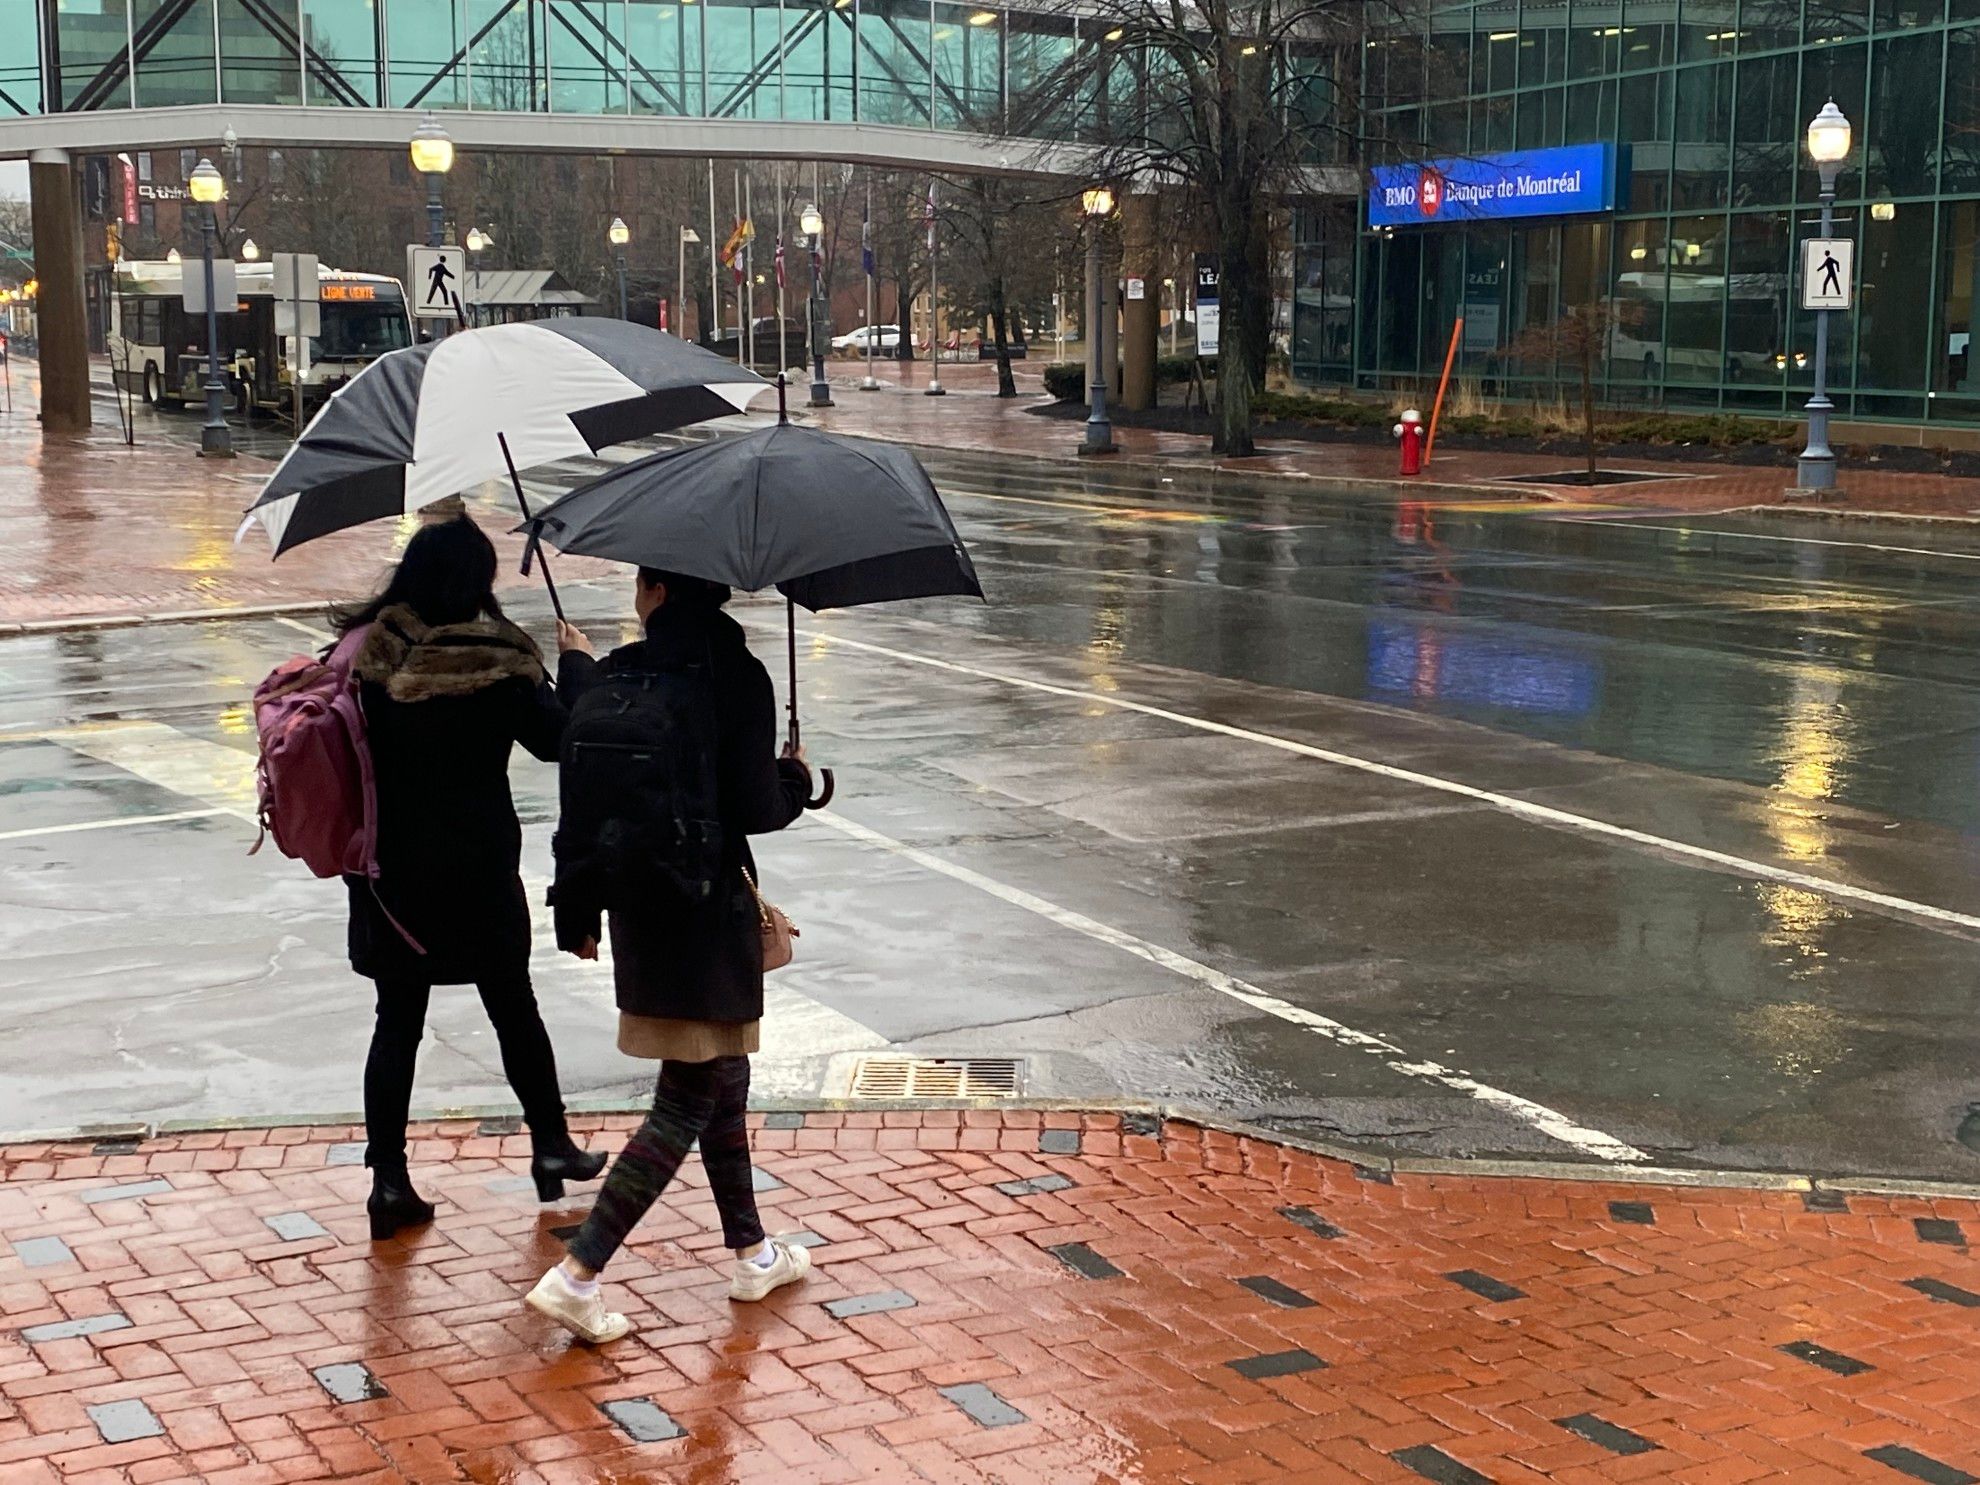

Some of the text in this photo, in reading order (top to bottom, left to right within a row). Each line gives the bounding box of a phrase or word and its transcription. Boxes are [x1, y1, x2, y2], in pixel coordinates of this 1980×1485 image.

[1386, 171, 1580, 206] BMO Banque de Montréal
